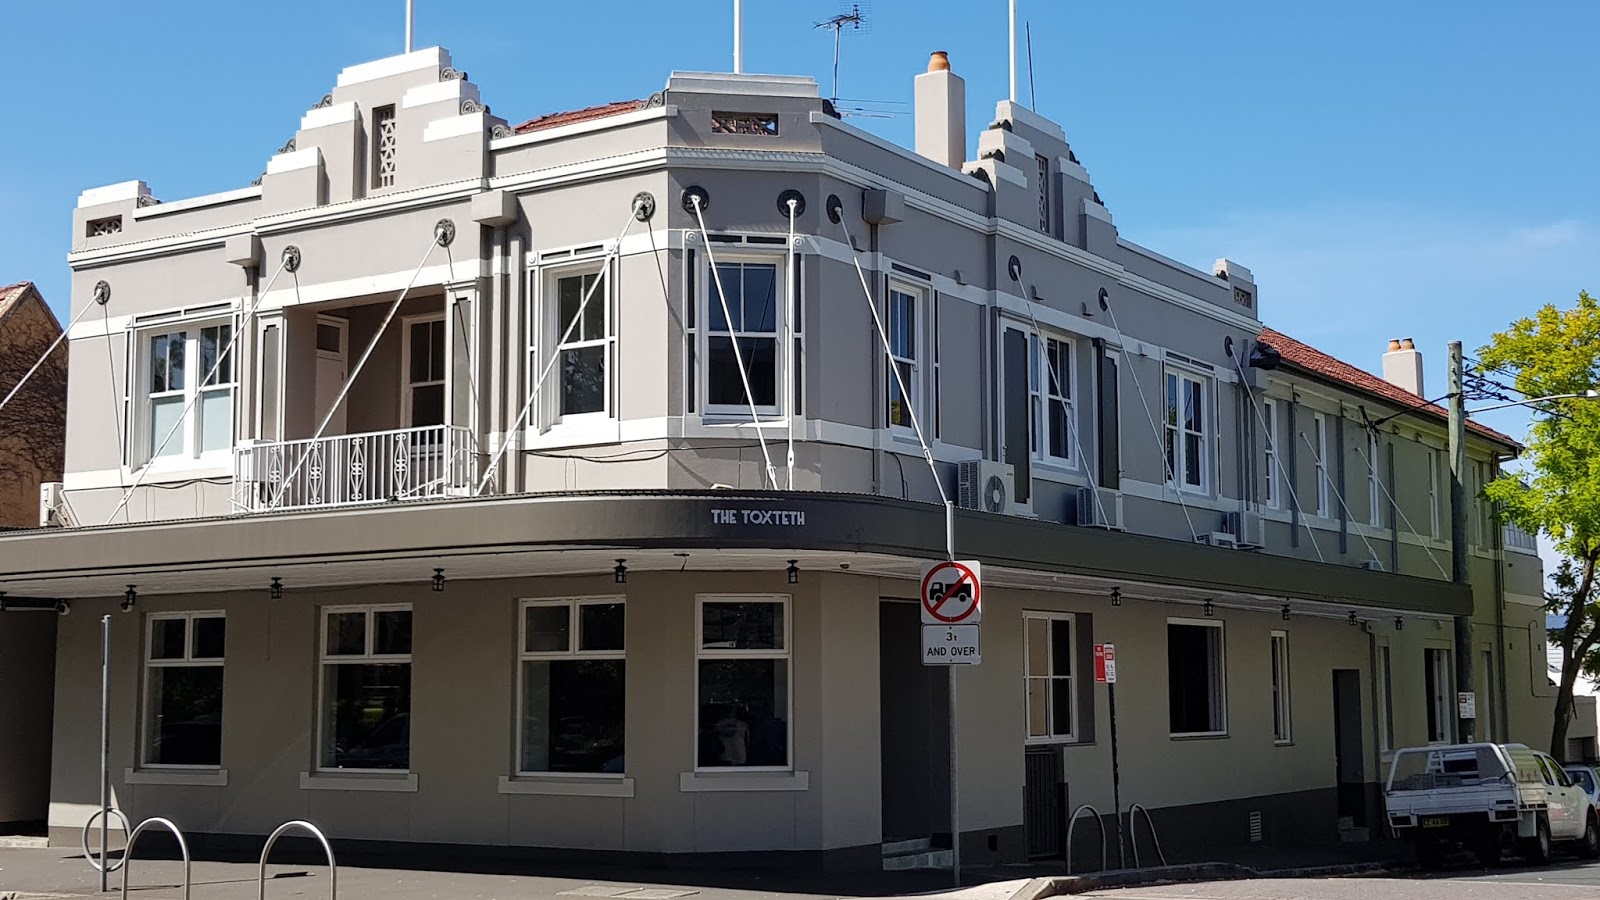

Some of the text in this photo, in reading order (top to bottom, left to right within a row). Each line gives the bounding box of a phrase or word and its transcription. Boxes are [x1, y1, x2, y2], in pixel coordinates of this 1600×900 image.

[711, 510, 805, 525] THE TOXTETH
[946, 632, 957, 641] 3t
[927, 647, 975, 656] AND OVER
